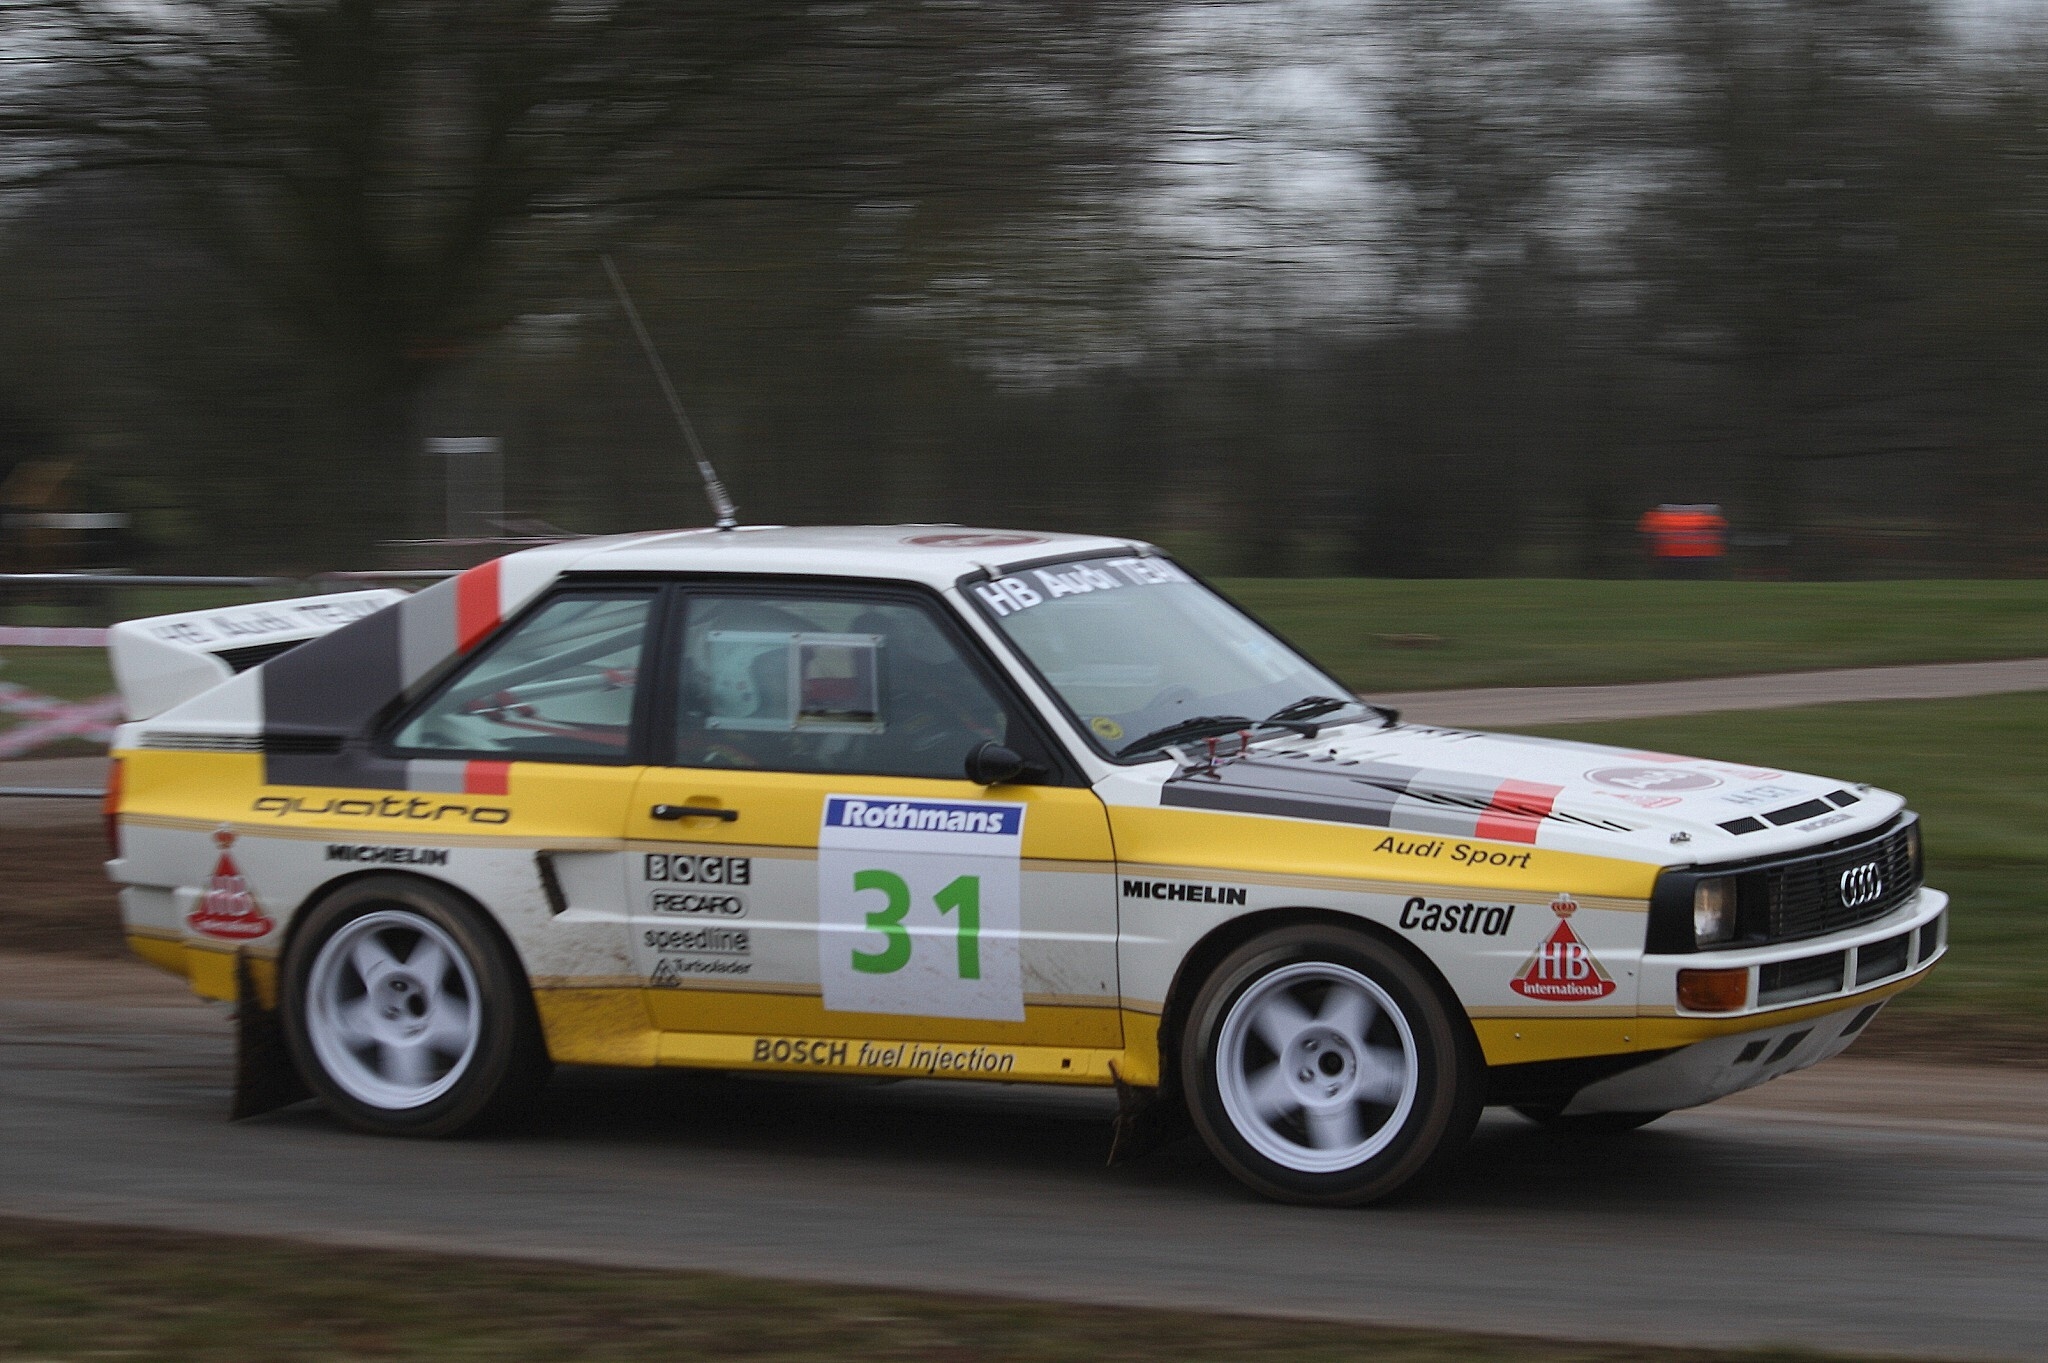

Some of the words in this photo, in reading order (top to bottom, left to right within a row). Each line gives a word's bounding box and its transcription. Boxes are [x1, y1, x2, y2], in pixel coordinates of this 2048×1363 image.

[975, 577, 1043, 616] HB
[1033, 564, 1124, 598] Audi
[252, 796, 512, 825] quattro
[841, 800, 1004, 834] Rothmans
[325, 844, 449, 866] MICHELIN
[646, 854, 750, 884] BOGE
[1373, 836, 1445, 858] Audi
[1450, 844, 1532, 870] Sport
[652, 893, 742, 914] RECARO
[1123, 879, 1247, 906] MICHELIN
[851, 868, 981, 980] 31
[1399, 897, 1515, 936] Castrol
[644, 928, 749, 953] speedline
[1537, 941, 1591, 981] HB
[1523, 981, 1604, 997] international
[753, 1038, 848, 1065] BOSCH
[858, 1040, 905, 1068] fuel
[910, 1043, 1016, 1074] injection
